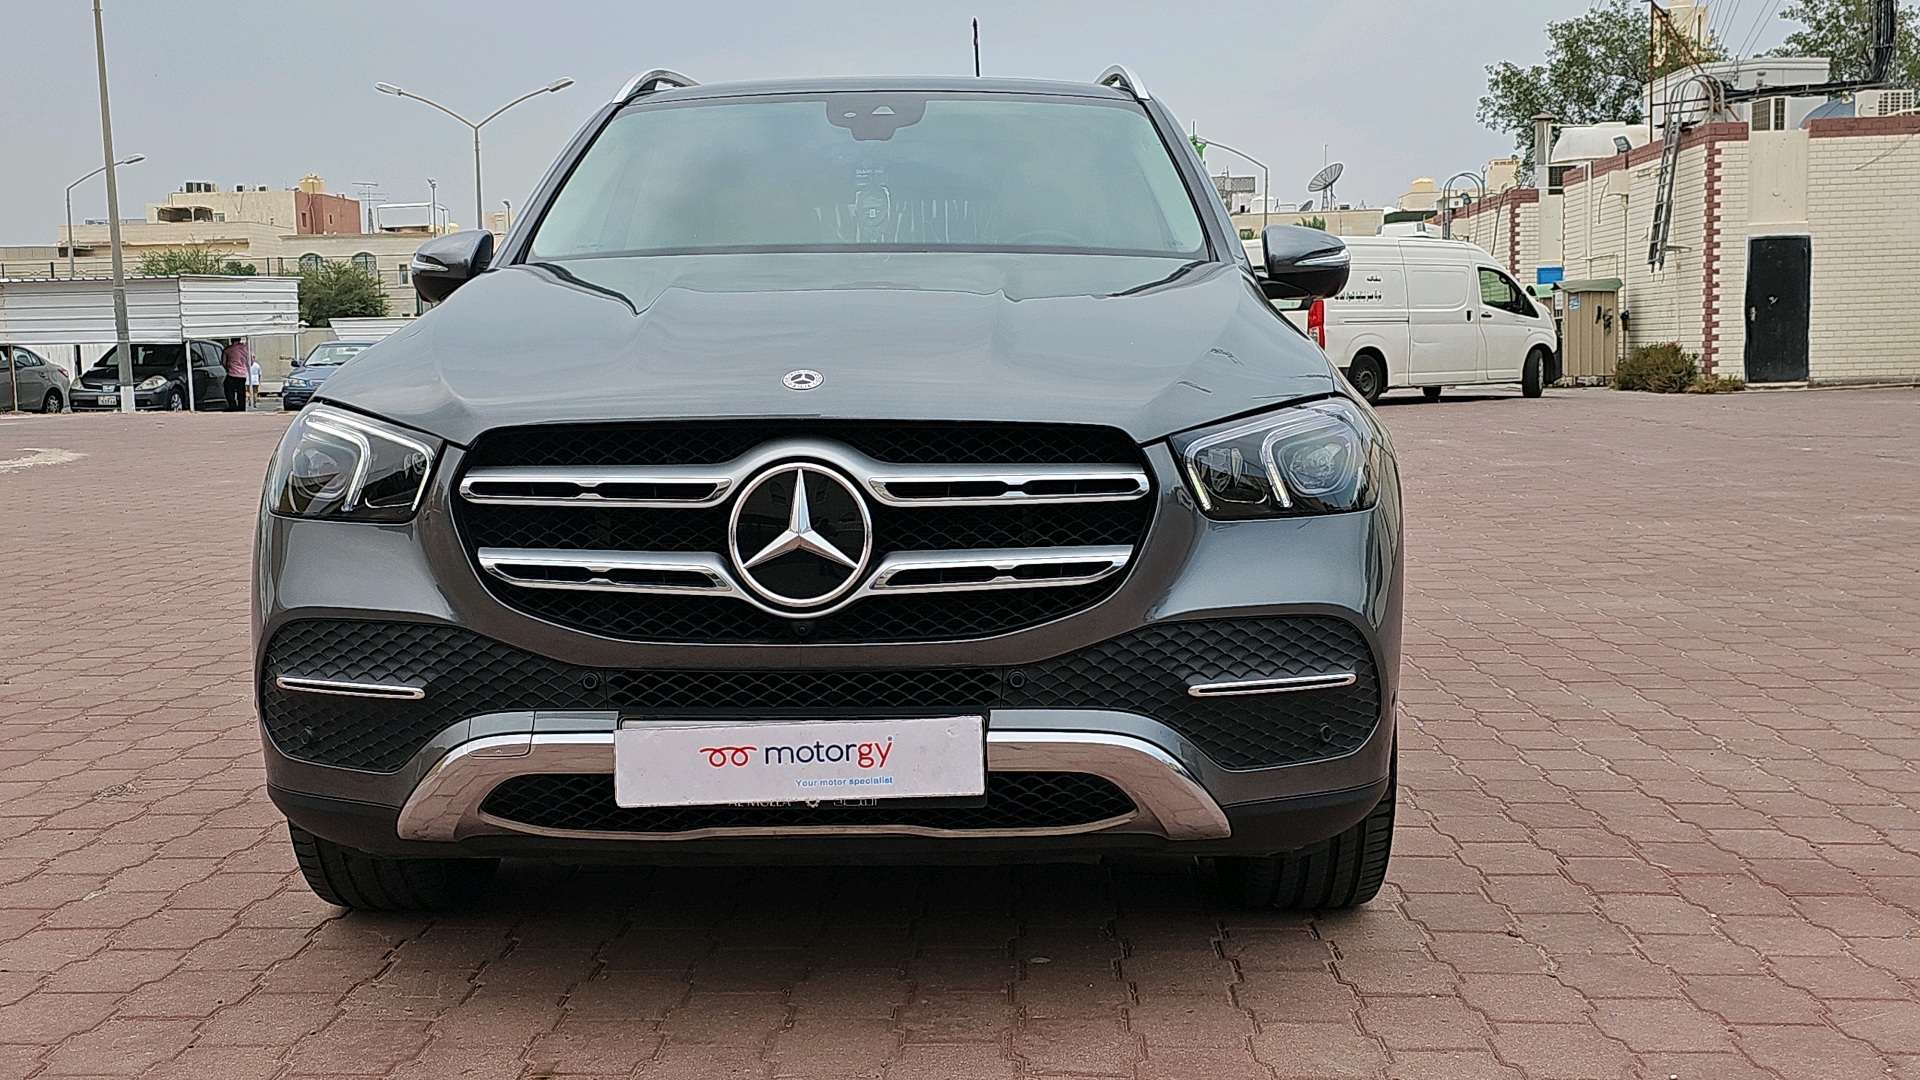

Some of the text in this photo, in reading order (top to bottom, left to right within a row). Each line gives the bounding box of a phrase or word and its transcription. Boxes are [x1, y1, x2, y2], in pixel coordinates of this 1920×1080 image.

[764, 740, 893, 768] motorgy
[795, 776, 893, 787] Your motor specialist
